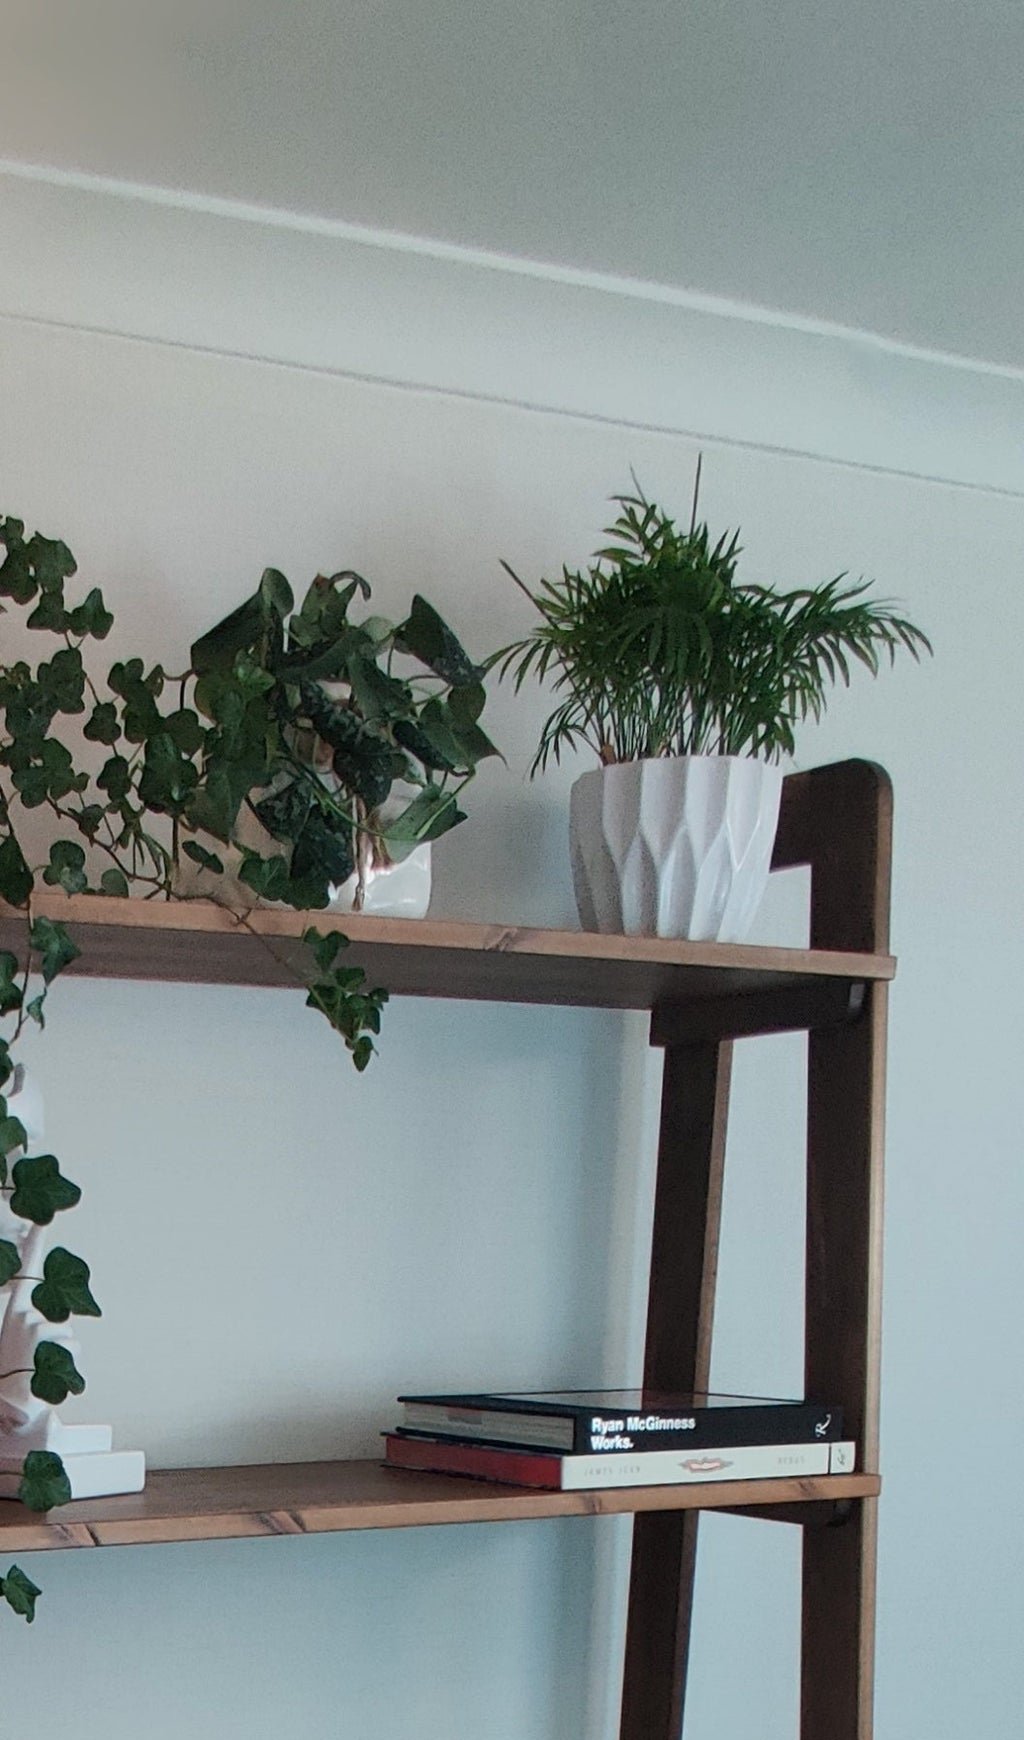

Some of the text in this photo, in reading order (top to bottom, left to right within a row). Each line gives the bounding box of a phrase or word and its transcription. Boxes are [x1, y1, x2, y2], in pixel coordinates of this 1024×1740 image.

[591, 1415, 696, 1435] Ryan McGinness
[590, 1434, 634, 1450] Works.
